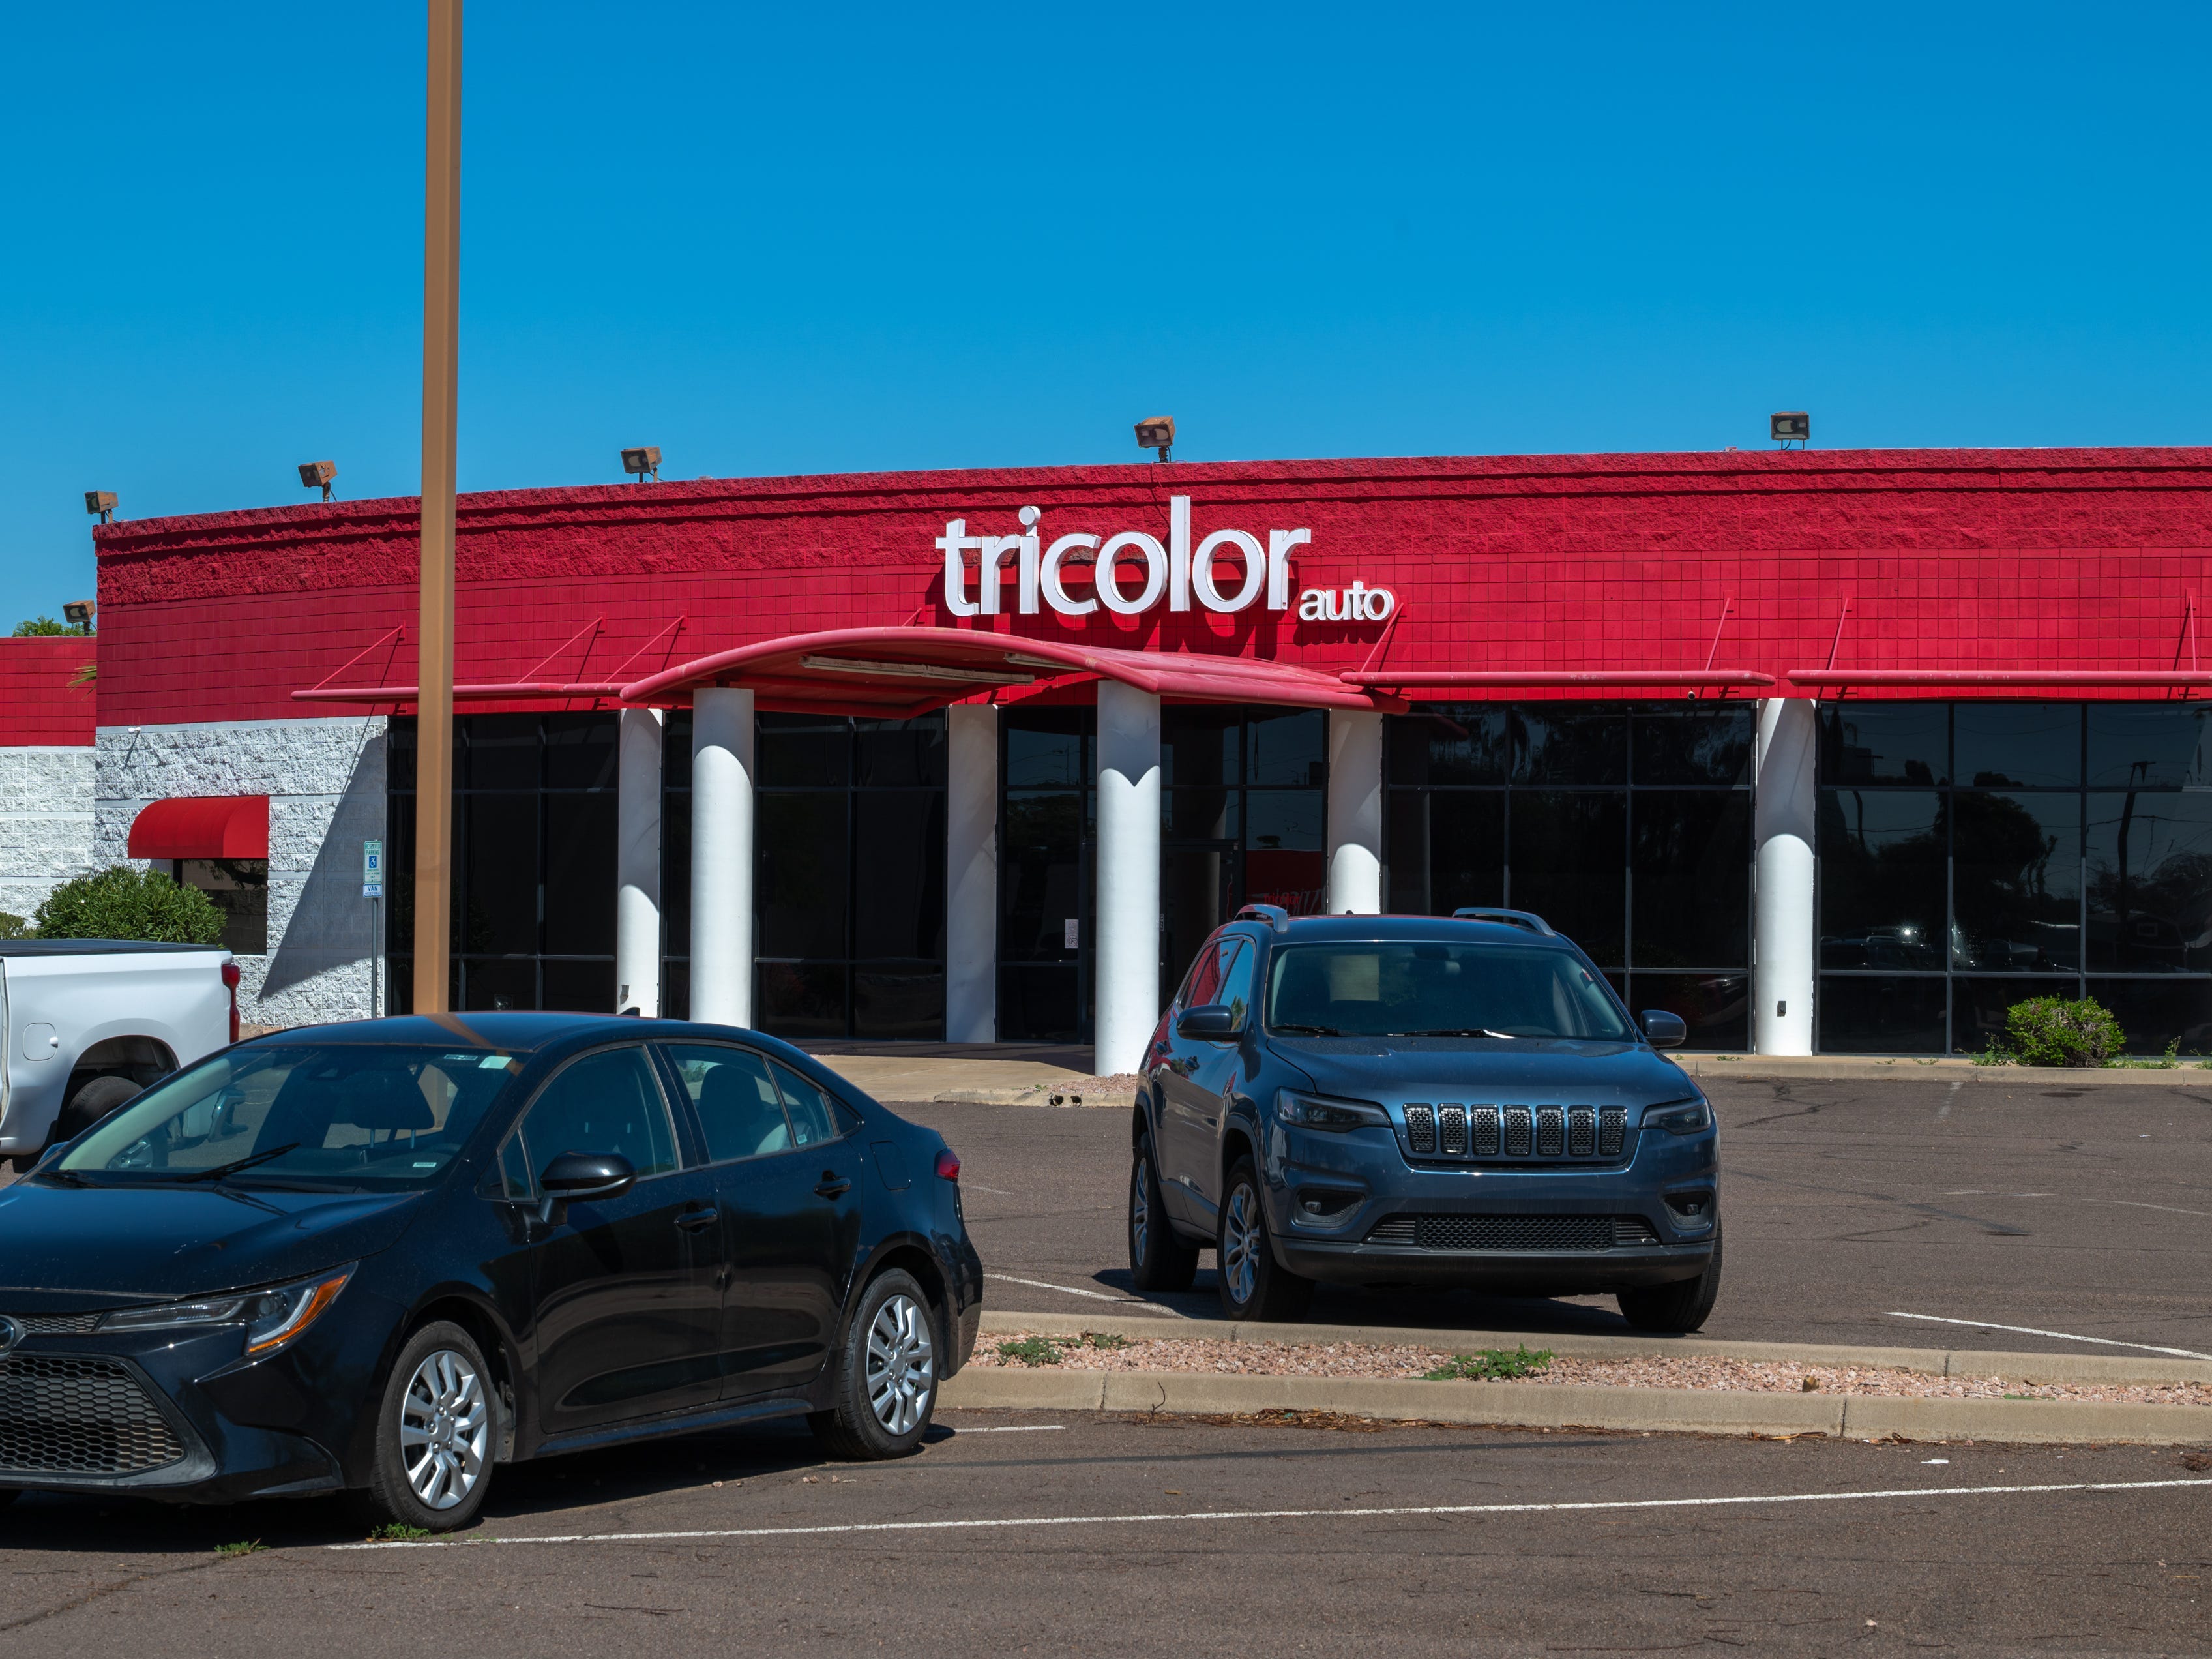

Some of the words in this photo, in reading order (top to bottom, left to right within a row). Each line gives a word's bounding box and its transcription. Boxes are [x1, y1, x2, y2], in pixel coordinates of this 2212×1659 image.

[935, 494, 1311, 617] tricolor
[1299, 580, 1395, 621] auto
[1263, 893, 1300, 904] tricolor
